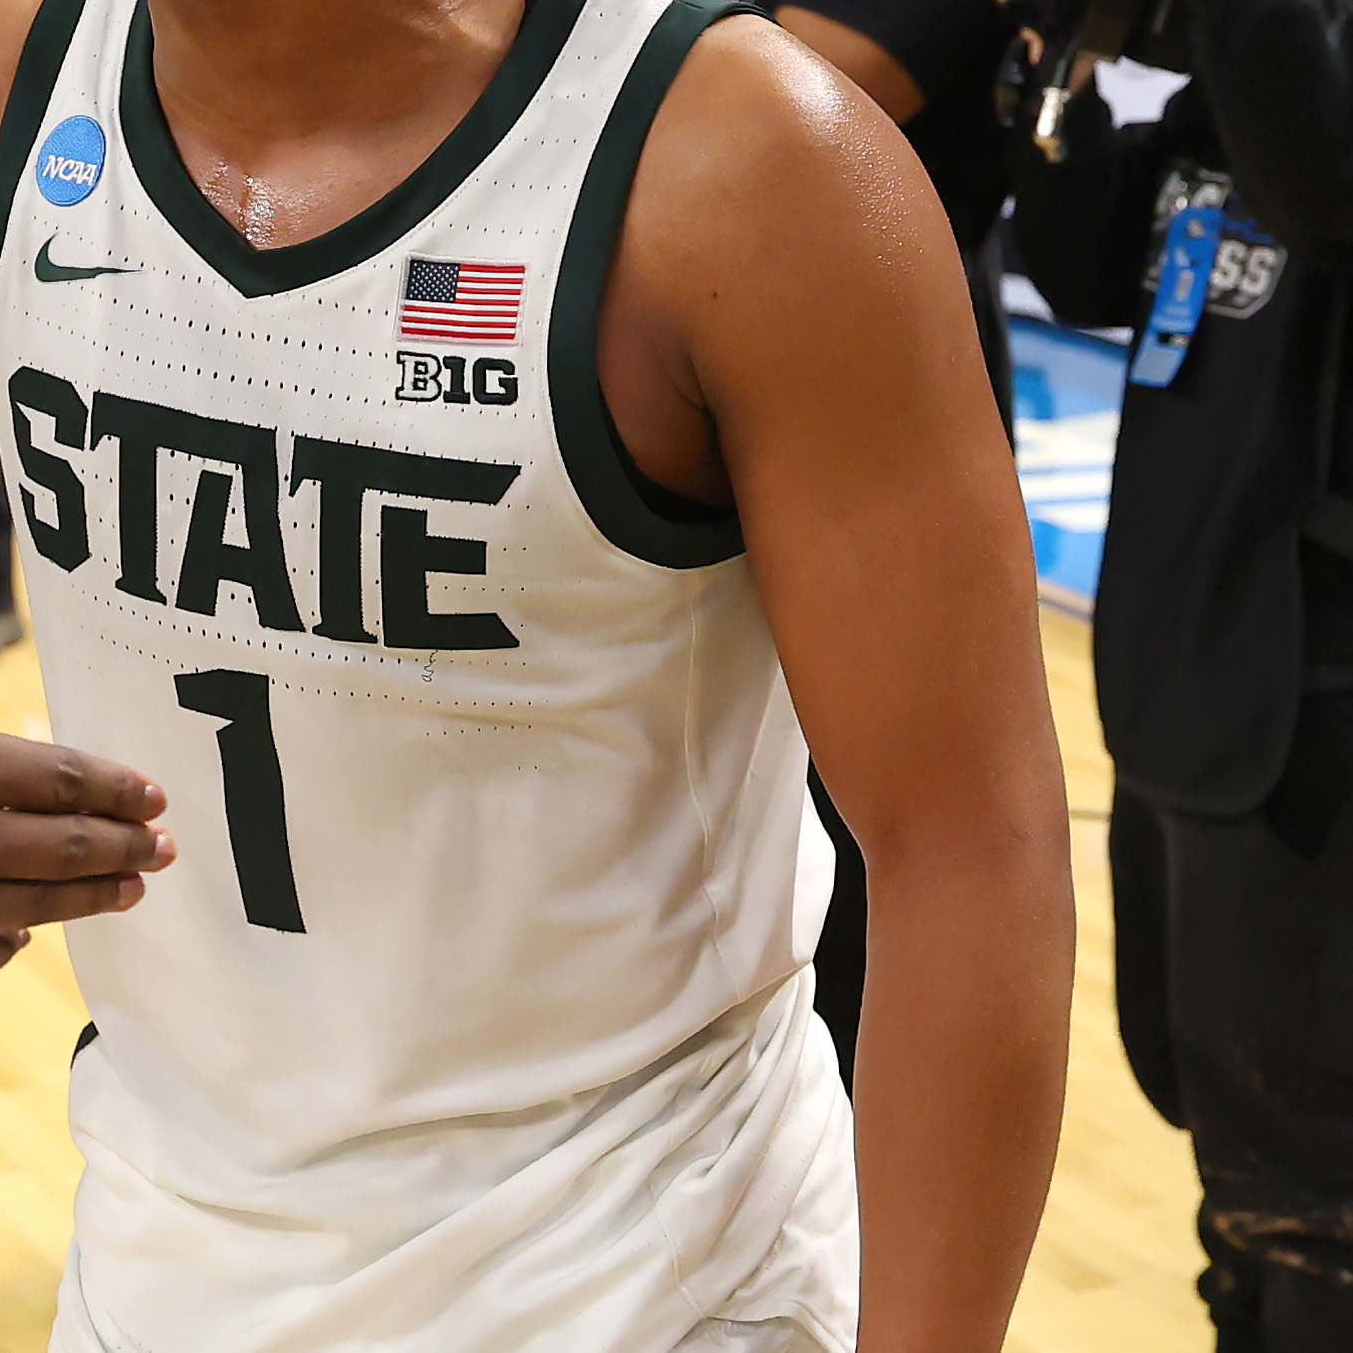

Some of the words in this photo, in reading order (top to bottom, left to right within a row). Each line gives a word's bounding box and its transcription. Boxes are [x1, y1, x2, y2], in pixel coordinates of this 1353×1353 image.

[42, 154, 98, 186] NCAA
[7, 365, 522, 651] STATE
[174, 668, 307, 934] 1
